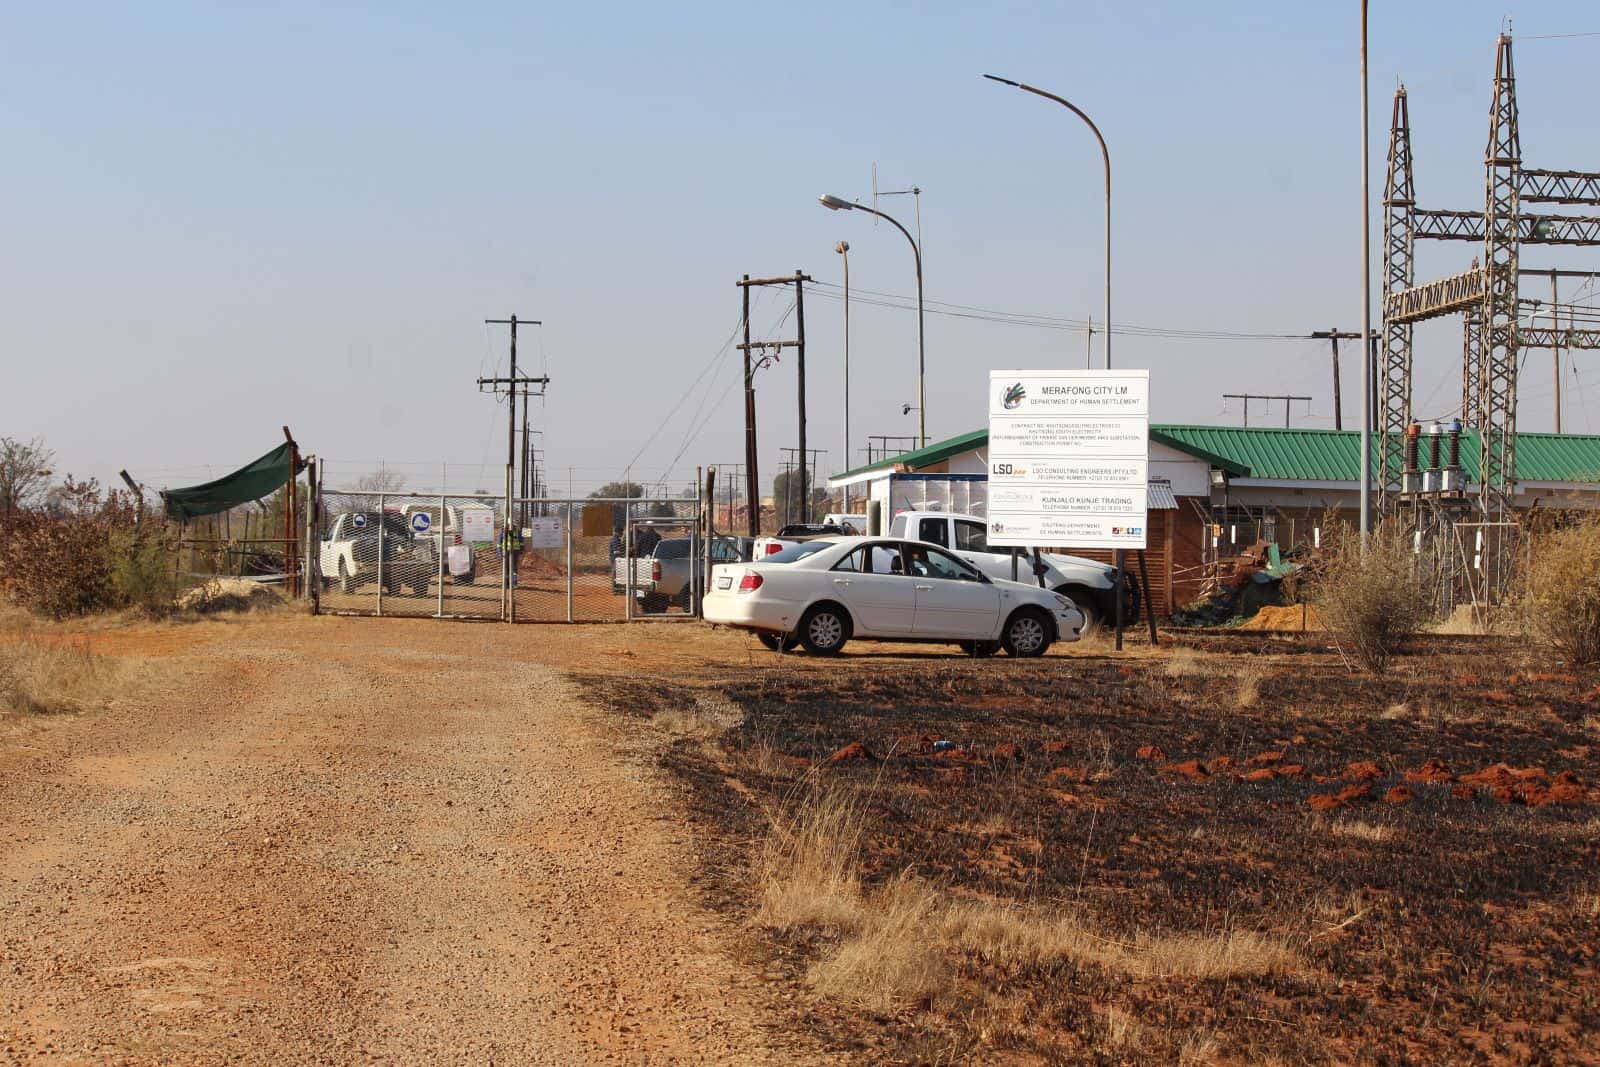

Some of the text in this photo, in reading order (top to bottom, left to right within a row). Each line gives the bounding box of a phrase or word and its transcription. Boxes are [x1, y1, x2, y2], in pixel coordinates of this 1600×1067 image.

[1042, 386, 1128, 395] MERAFONG CITY LM
[993, 464, 1013, 475] LSO
